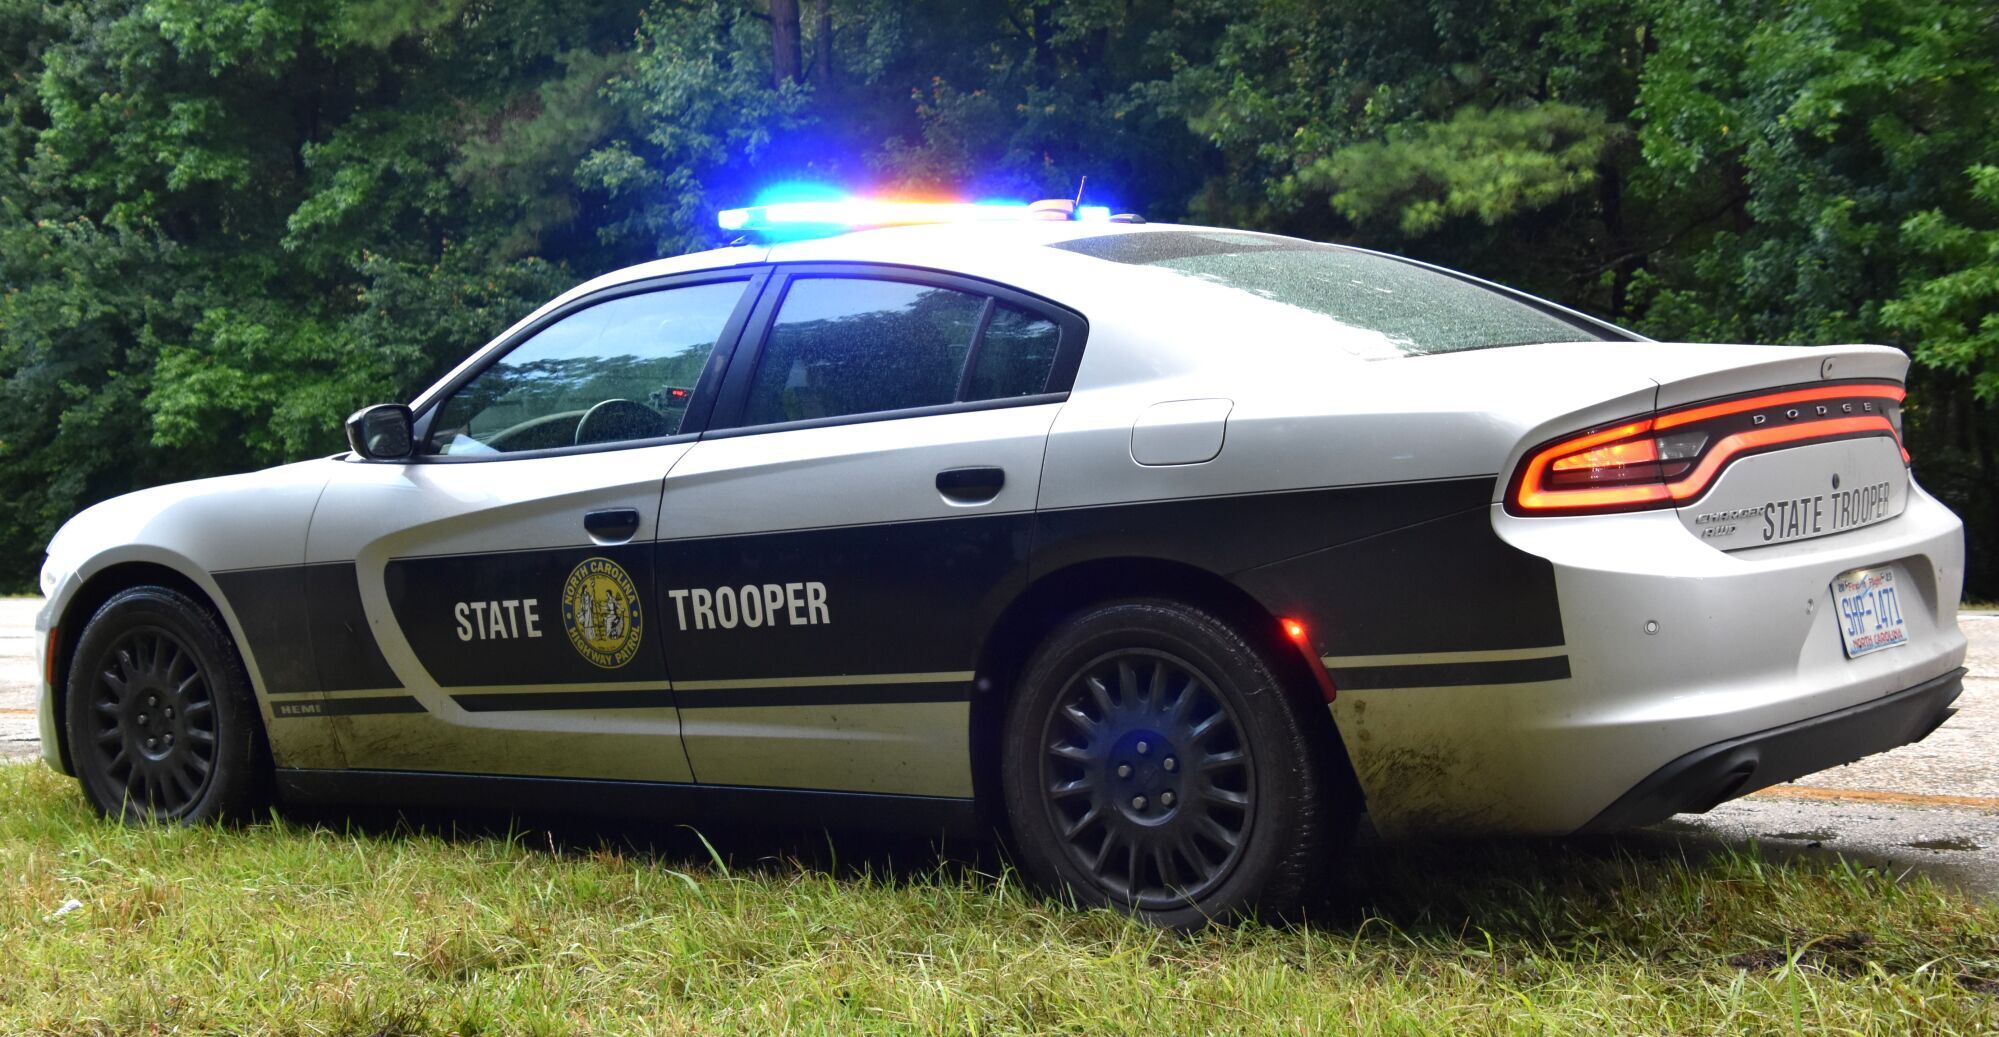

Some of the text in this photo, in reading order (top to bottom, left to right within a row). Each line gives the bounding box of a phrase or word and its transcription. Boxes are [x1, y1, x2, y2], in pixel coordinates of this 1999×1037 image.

[1753, 402, 1873, 425] DODGE
[1696, 506, 1765, 524] CHARGER
[1763, 481, 1890, 542] STATE TROOPER
[1701, 525, 1736, 539] AWD
[565, 561, 636, 605] NORTH CAROLINA
[454, 581, 831, 642] STATE TROOPER
[1842, 587, 1903, 636] SHP-1471
[569, 625, 640, 665] HIGHWAY PATROL
[1852, 628, 1903, 647] NORTH CAROLINA
[280, 704, 321, 714] HEMI
